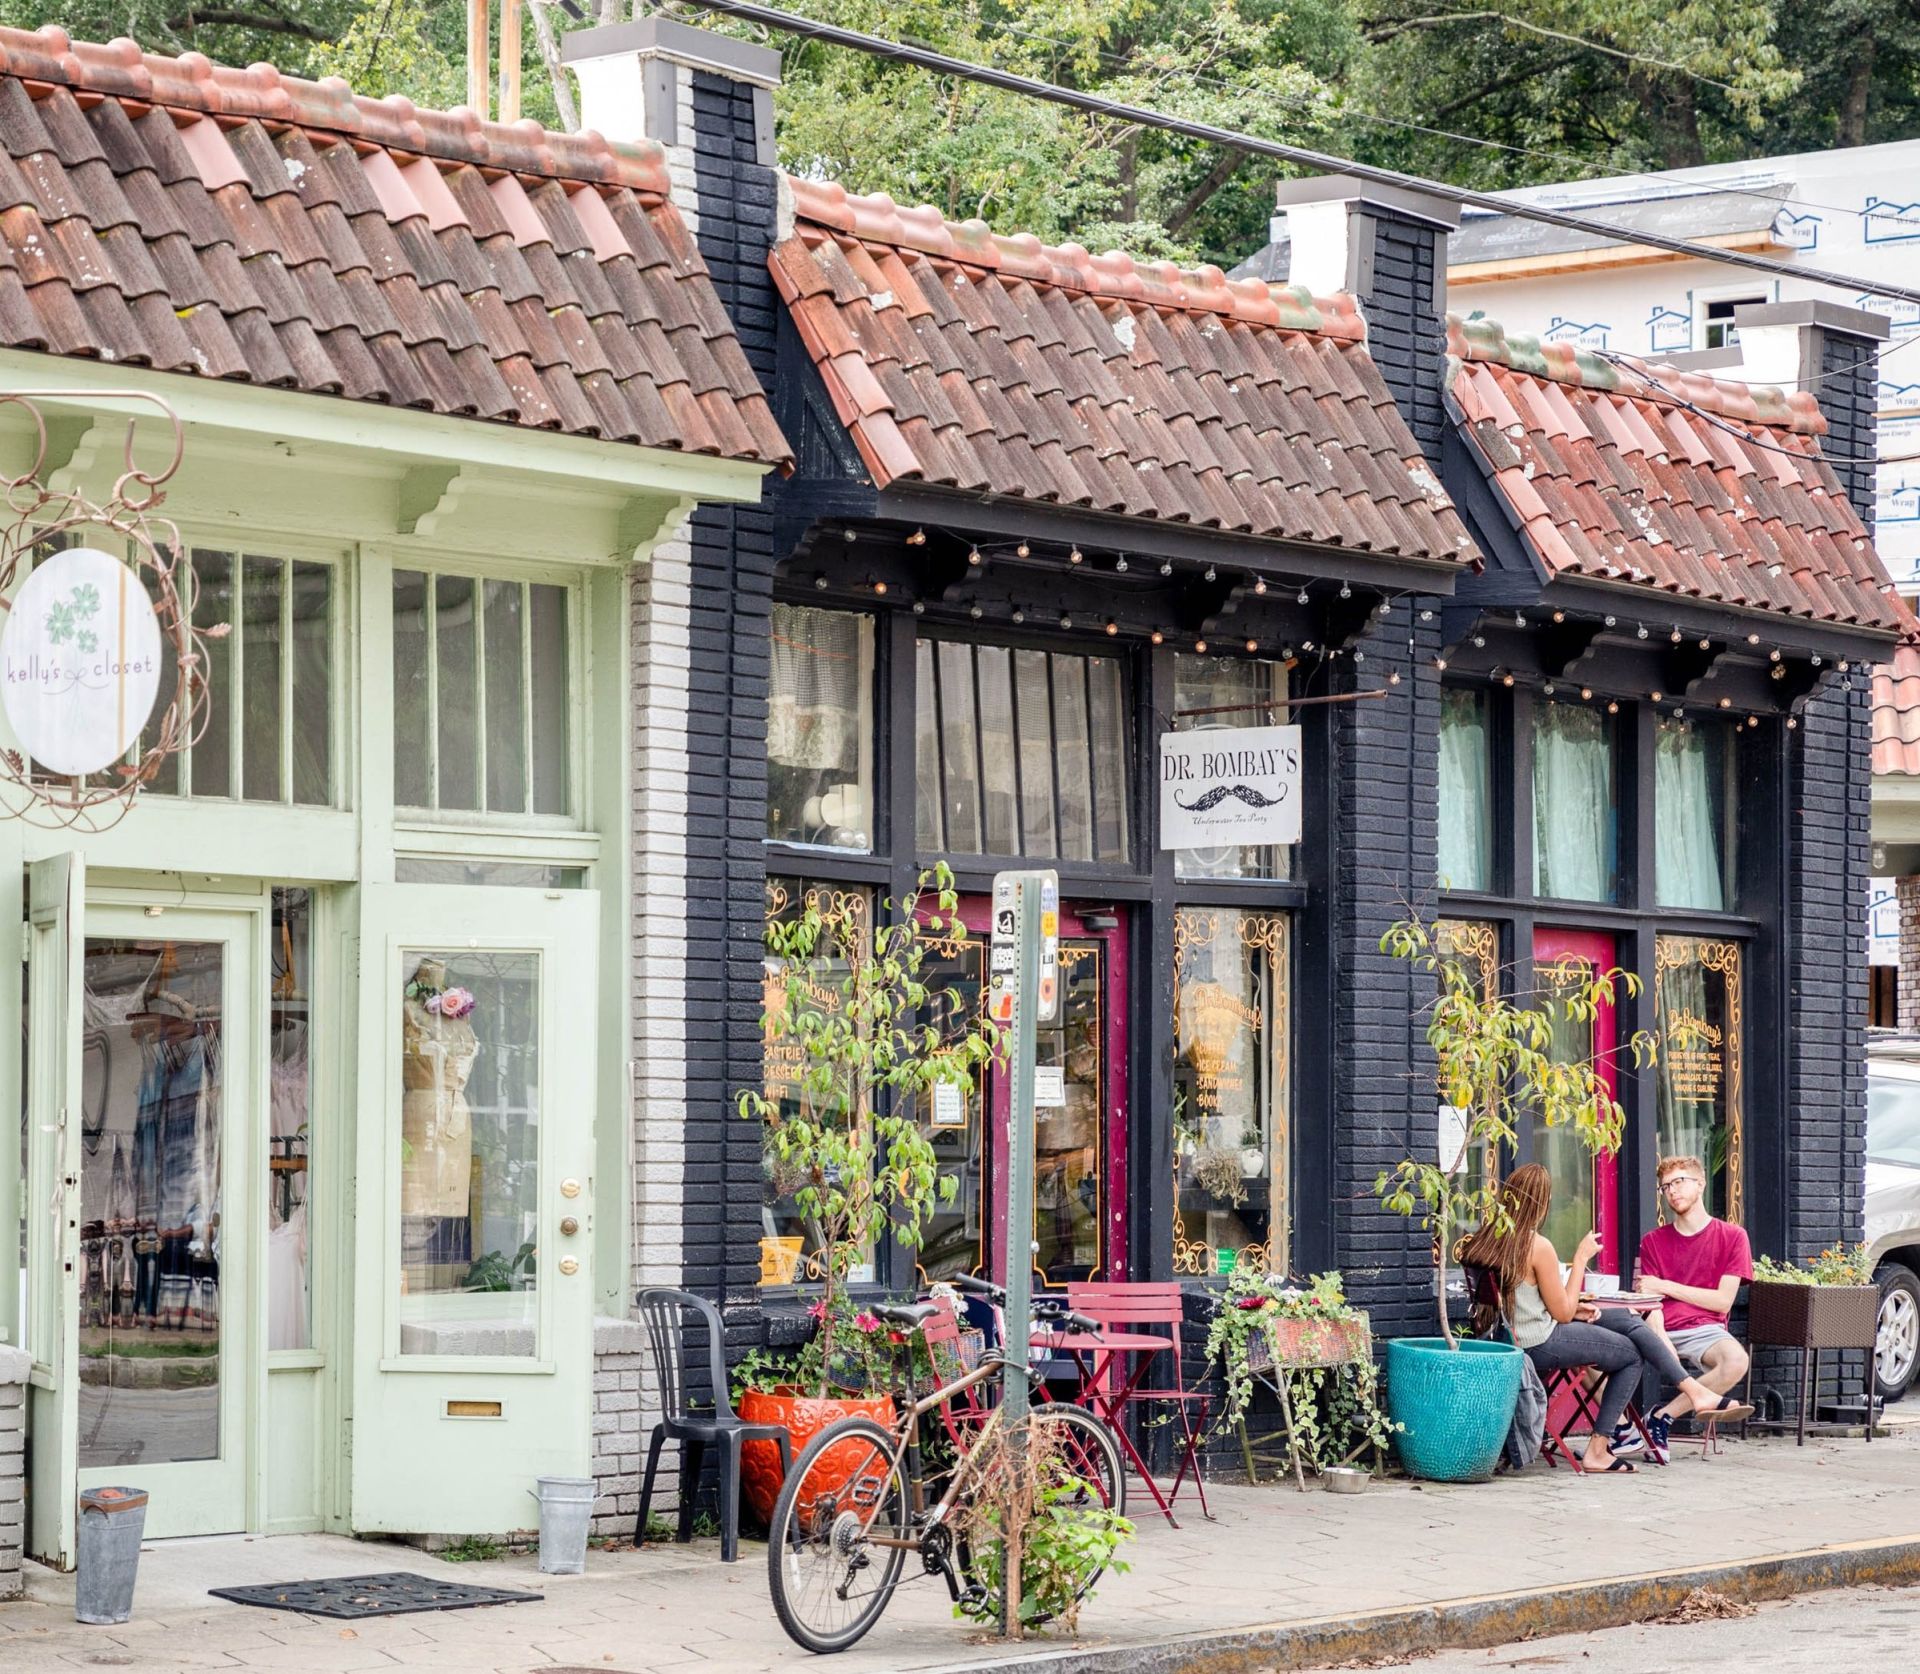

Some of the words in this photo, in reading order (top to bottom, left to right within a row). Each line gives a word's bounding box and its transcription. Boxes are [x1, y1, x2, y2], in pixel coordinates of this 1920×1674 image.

[1894, 304, 1916, 312] Wrap
[1657, 321, 1681, 329] Prime
[1555, 332, 1579, 340] Prime
[1579, 337, 1600, 345] Wrap
[1896, 398, 1919, 406] Wrap
[1892, 499, 1915, 508] Wrap
[7, 655, 61, 684] kelly's
[93, 650, 153, 676] closet
[1163, 754, 1194, 781] DR.
[1202, 748, 1297, 779] BOMBAY'S
